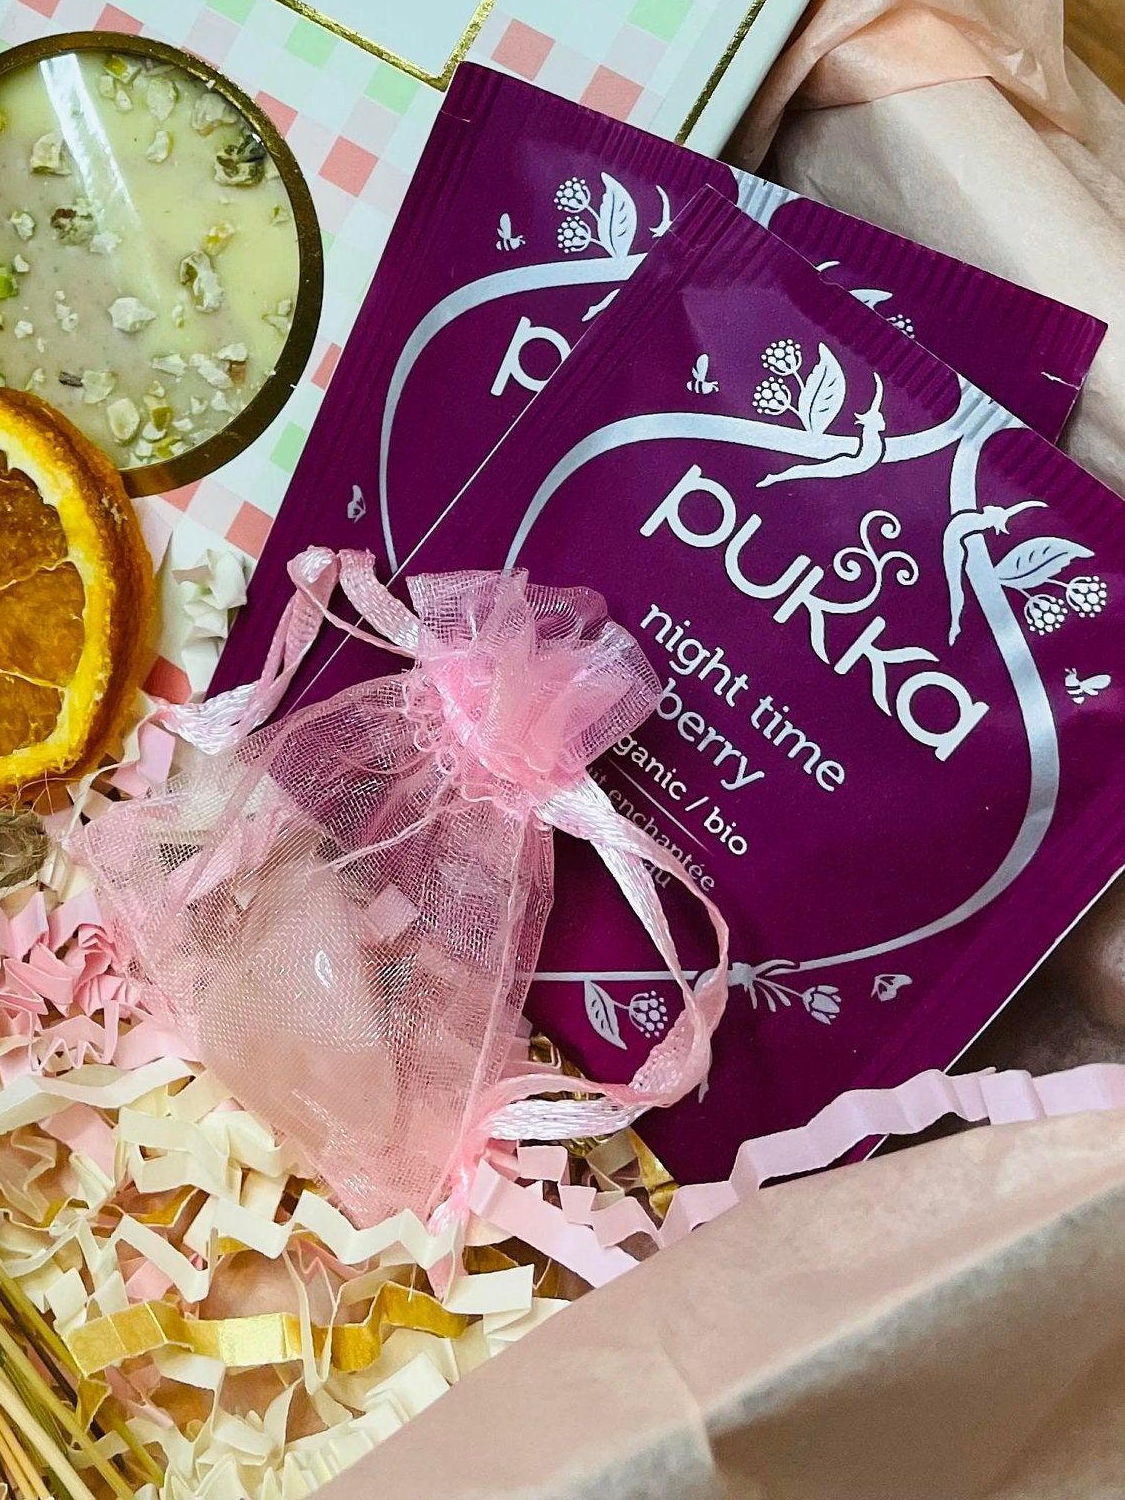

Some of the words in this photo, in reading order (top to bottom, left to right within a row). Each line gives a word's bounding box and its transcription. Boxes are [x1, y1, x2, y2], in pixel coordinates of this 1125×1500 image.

[640, 465, 990, 762] pukka
[639, 603, 749, 708] night
[750, 695, 846, 793] time
[655, 677, 765, 791] berry
[612, 733, 688, 801] ganic
[703, 806, 748, 856] bio
